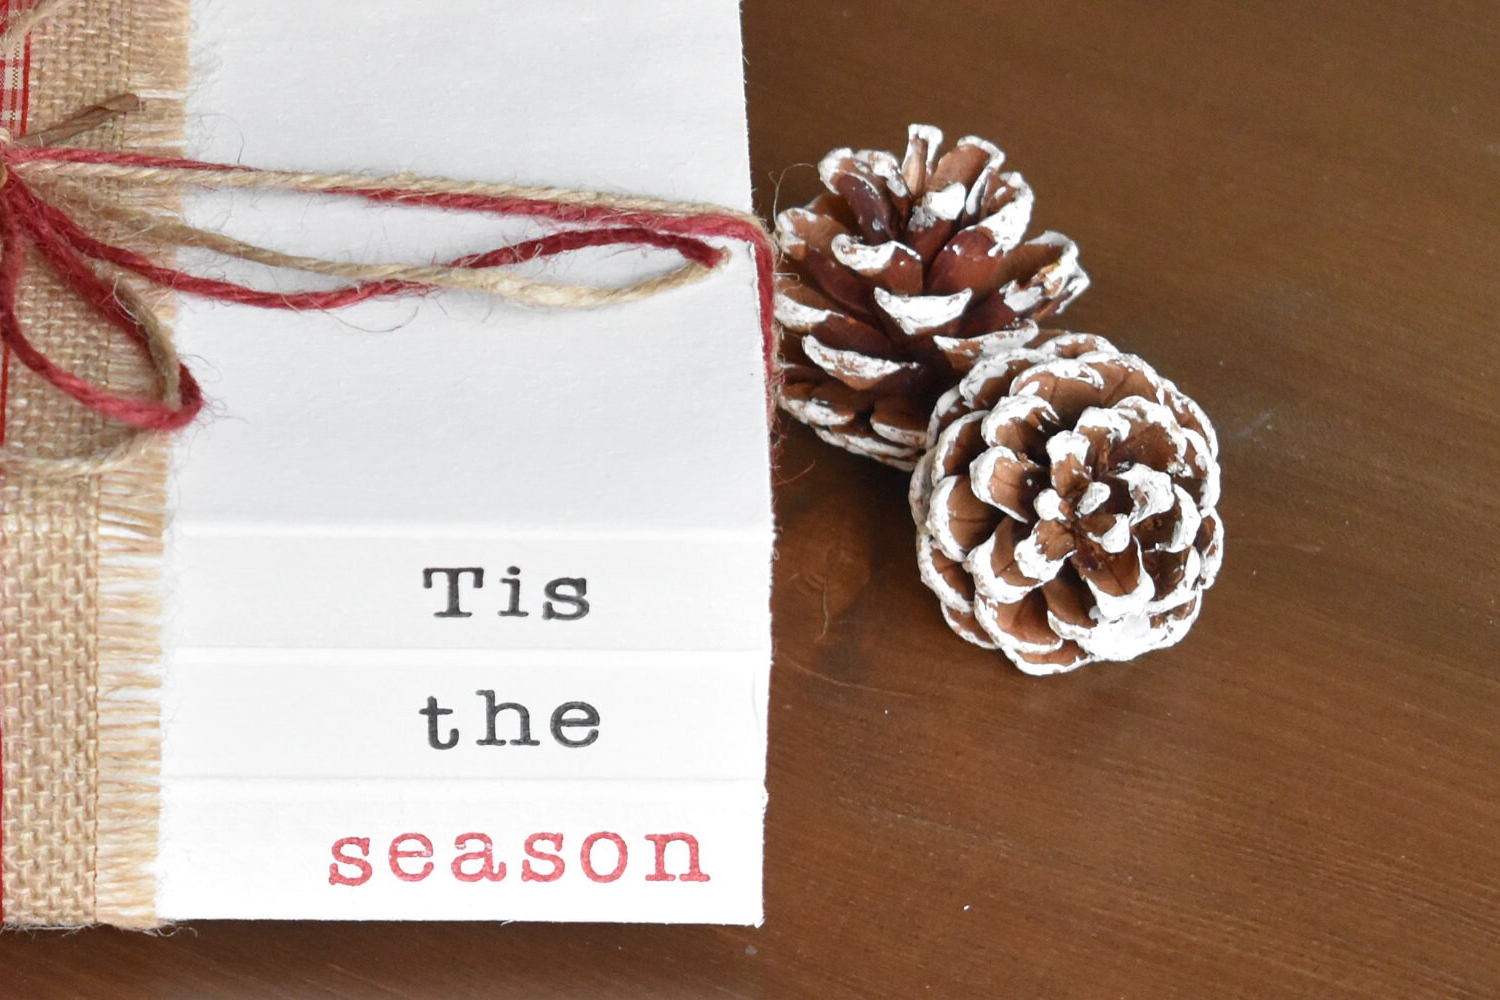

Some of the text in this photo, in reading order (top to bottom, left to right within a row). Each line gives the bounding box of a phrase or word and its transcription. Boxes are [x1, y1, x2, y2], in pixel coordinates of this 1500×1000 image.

[422, 565, 590, 621] Tis
[419, 689, 601, 750] the
[328, 831, 711, 886] season
